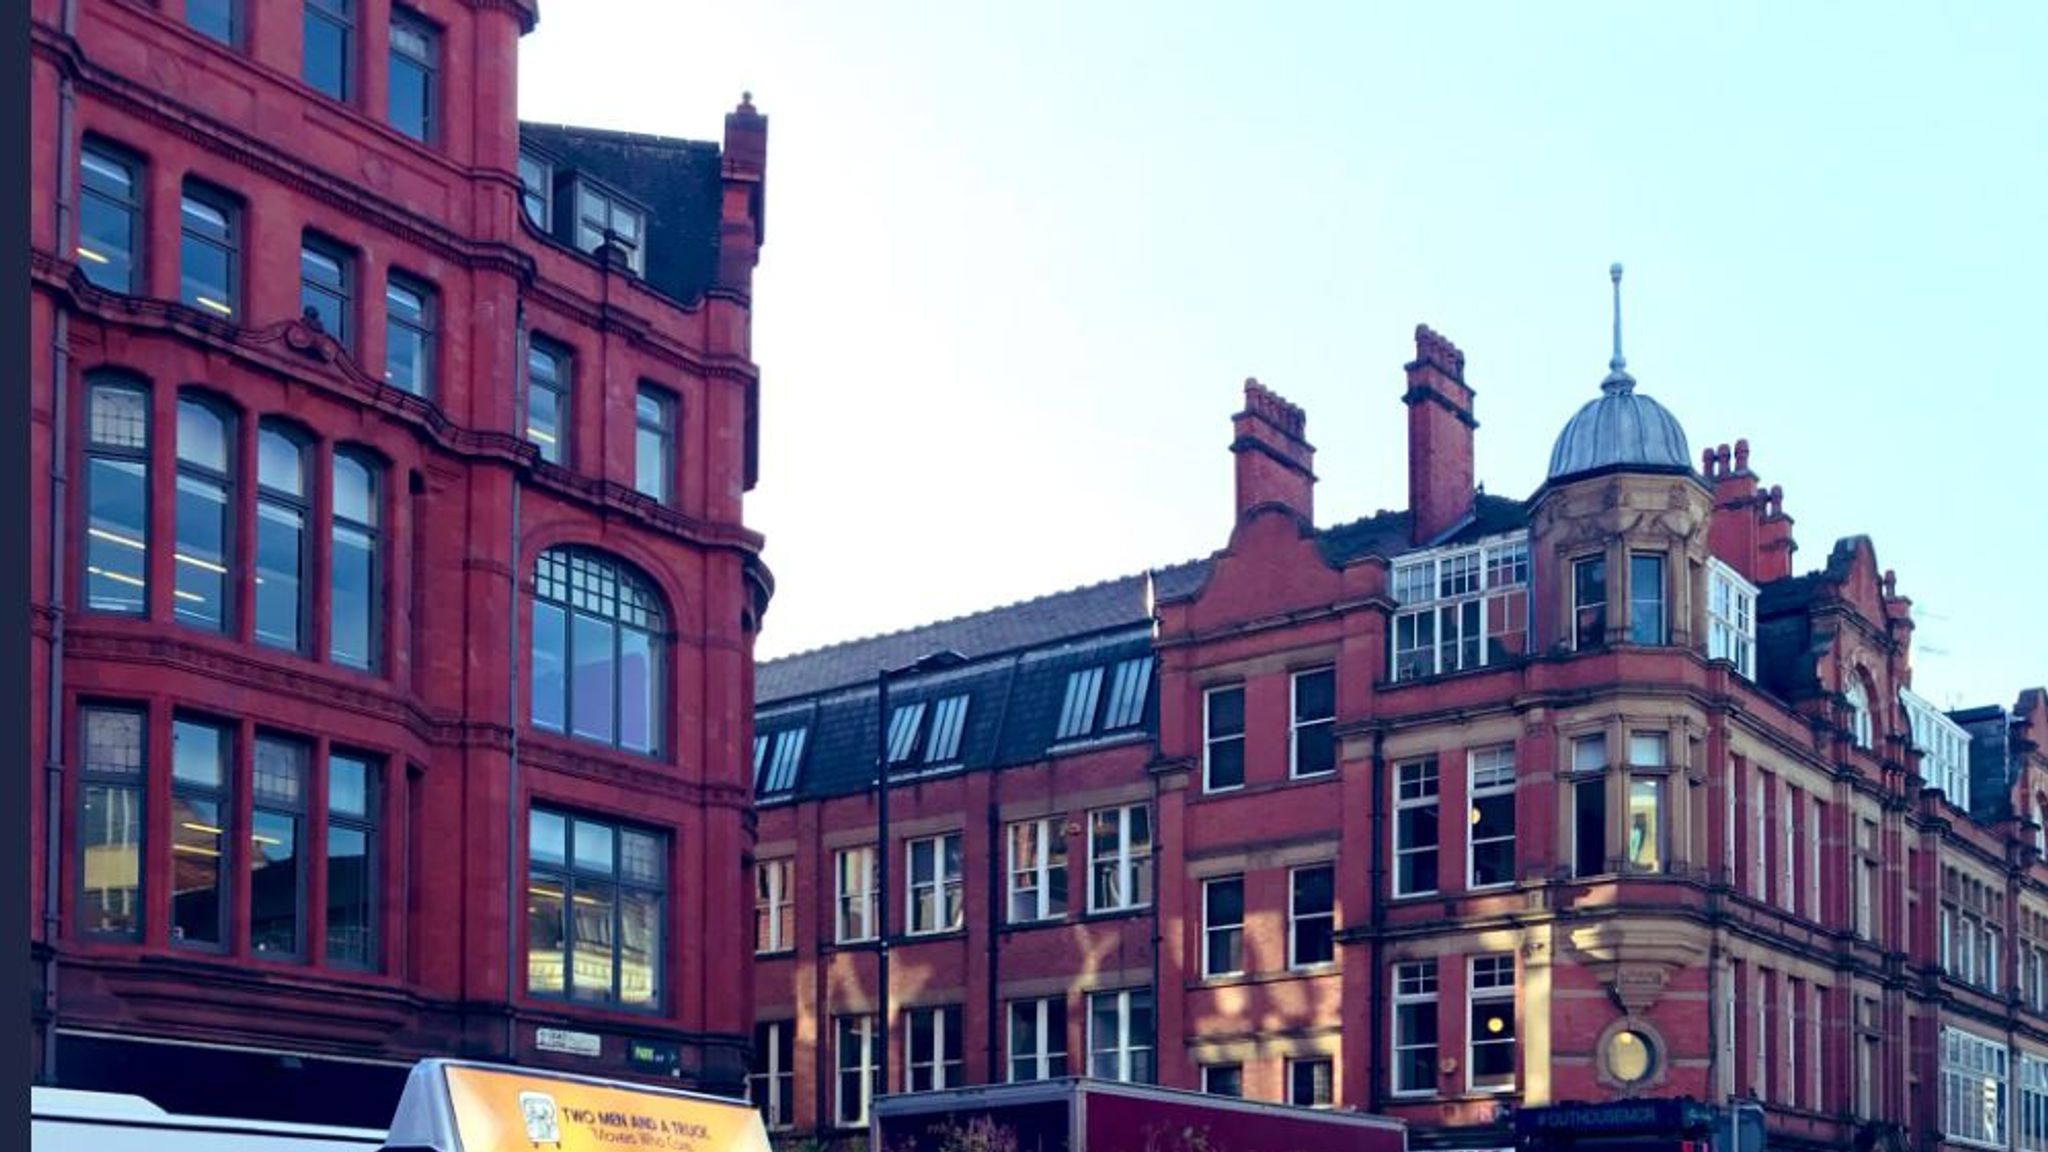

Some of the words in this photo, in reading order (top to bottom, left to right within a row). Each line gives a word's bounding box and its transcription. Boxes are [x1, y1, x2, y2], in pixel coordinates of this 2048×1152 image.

[561, 1107, 595, 1124] TWO
[598, 1110, 627, 1127] MEN
[631, 1114, 657, 1130] AND
[661, 1118, 669, 1133] A
[671, 1119, 710, 1139] TRUCK
